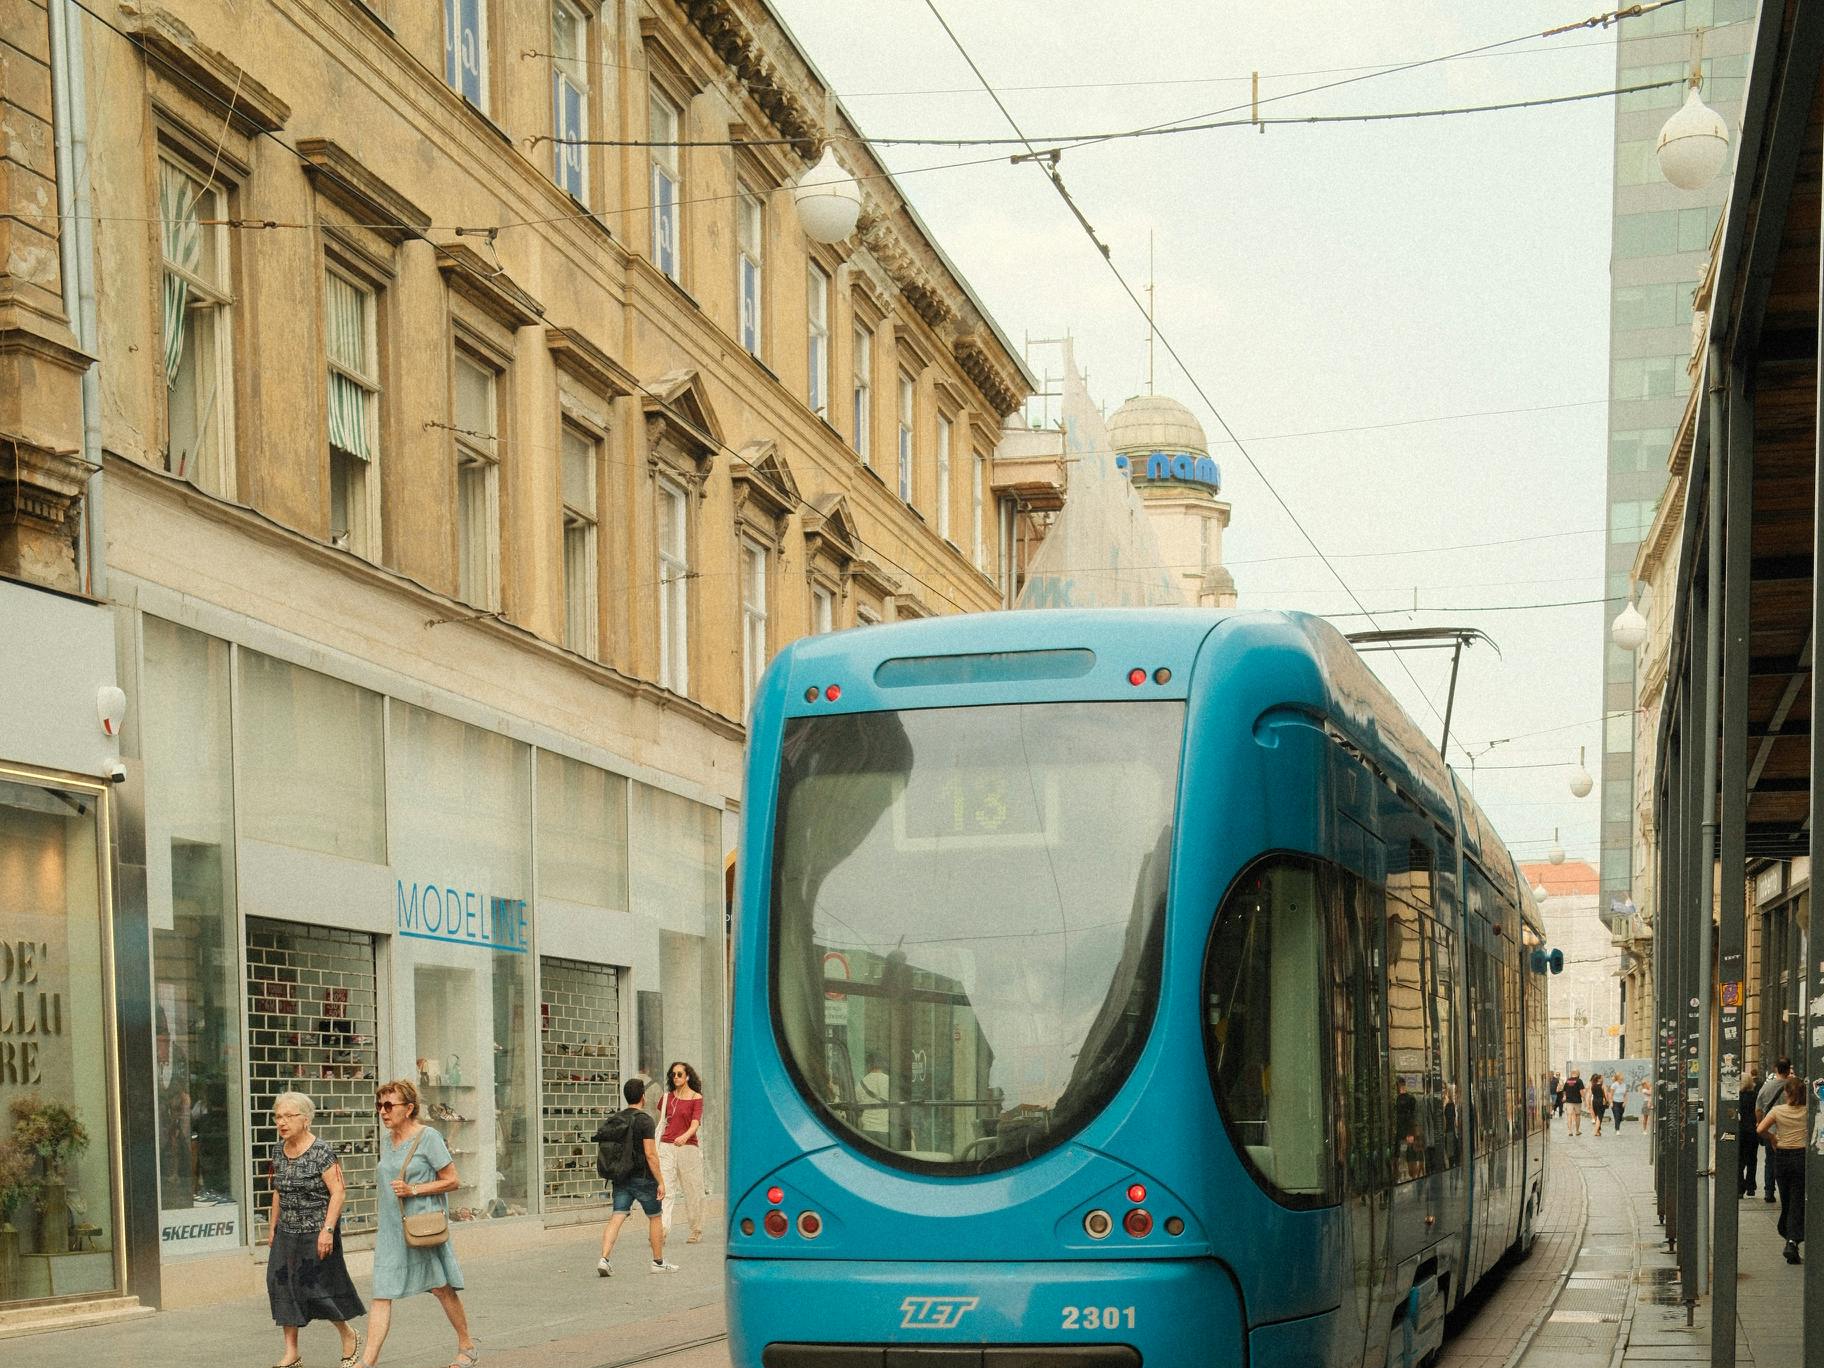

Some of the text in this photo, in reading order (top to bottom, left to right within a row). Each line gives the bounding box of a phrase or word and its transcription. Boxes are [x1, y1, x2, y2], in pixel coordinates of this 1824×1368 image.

[397, 879, 528, 946] MODELINE
[161, 1221, 235, 1242] SKECHERS
[900, 1296, 980, 1329] ZET
[1061, 1306, 1136, 1330] 2301
